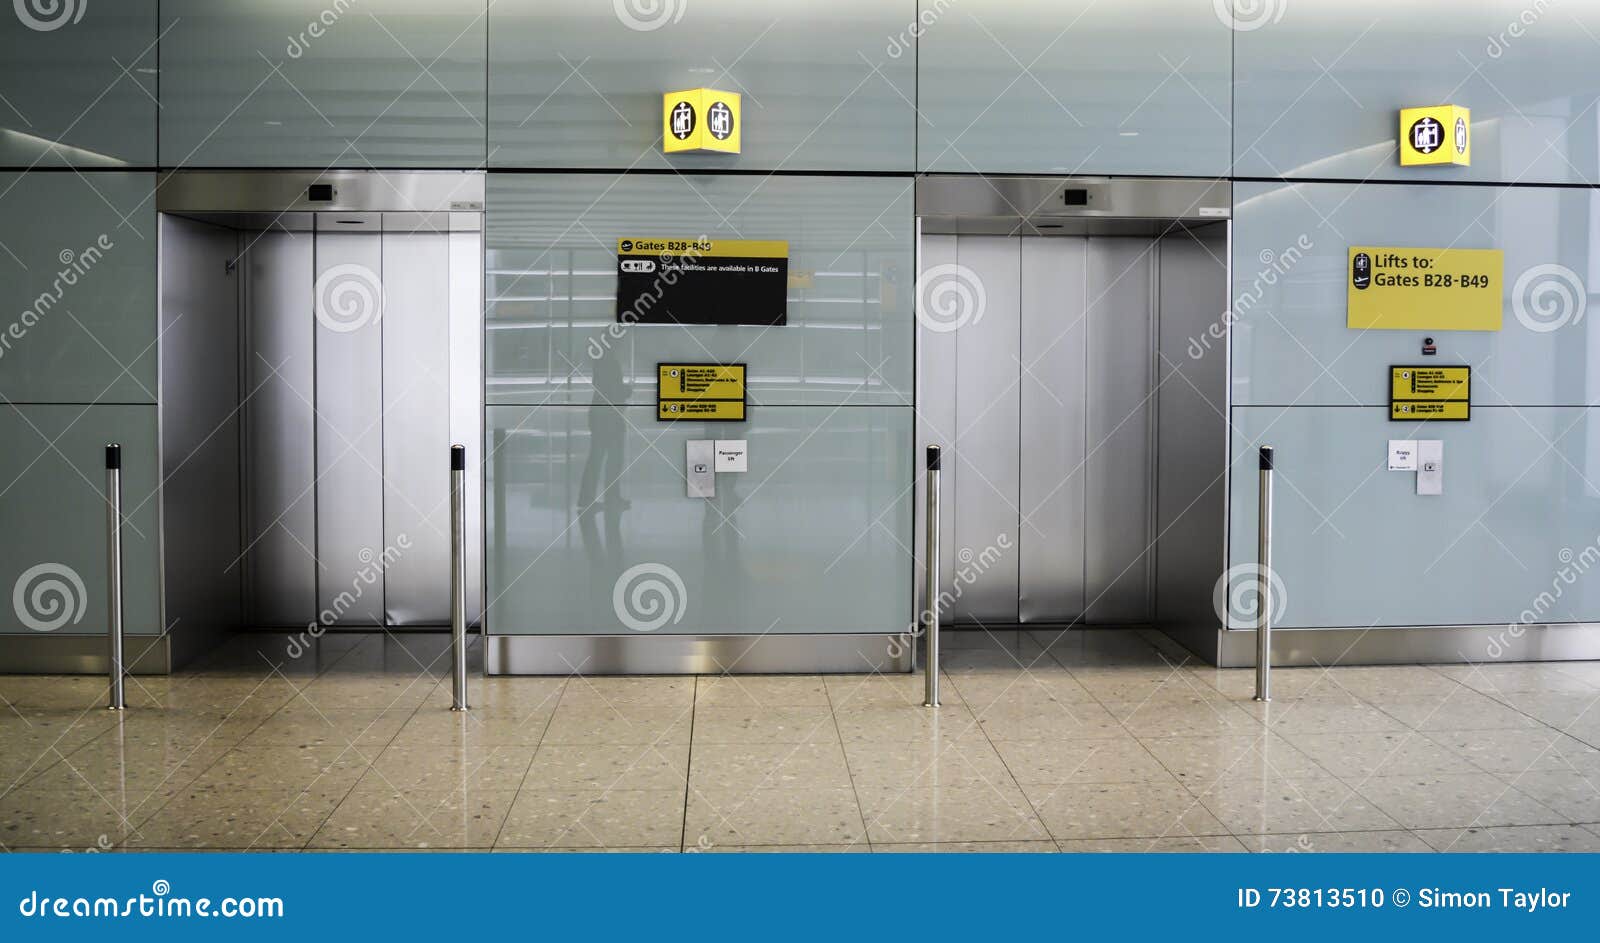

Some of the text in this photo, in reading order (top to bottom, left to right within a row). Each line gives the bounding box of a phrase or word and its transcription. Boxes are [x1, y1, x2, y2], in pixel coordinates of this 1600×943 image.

[636, 241, 665, 250] Gates
[661, 263, 679, 271] These
[1375, 254, 1433, 269] Lifts to:
[1374, 273, 1489, 288] Gates B28-B49
